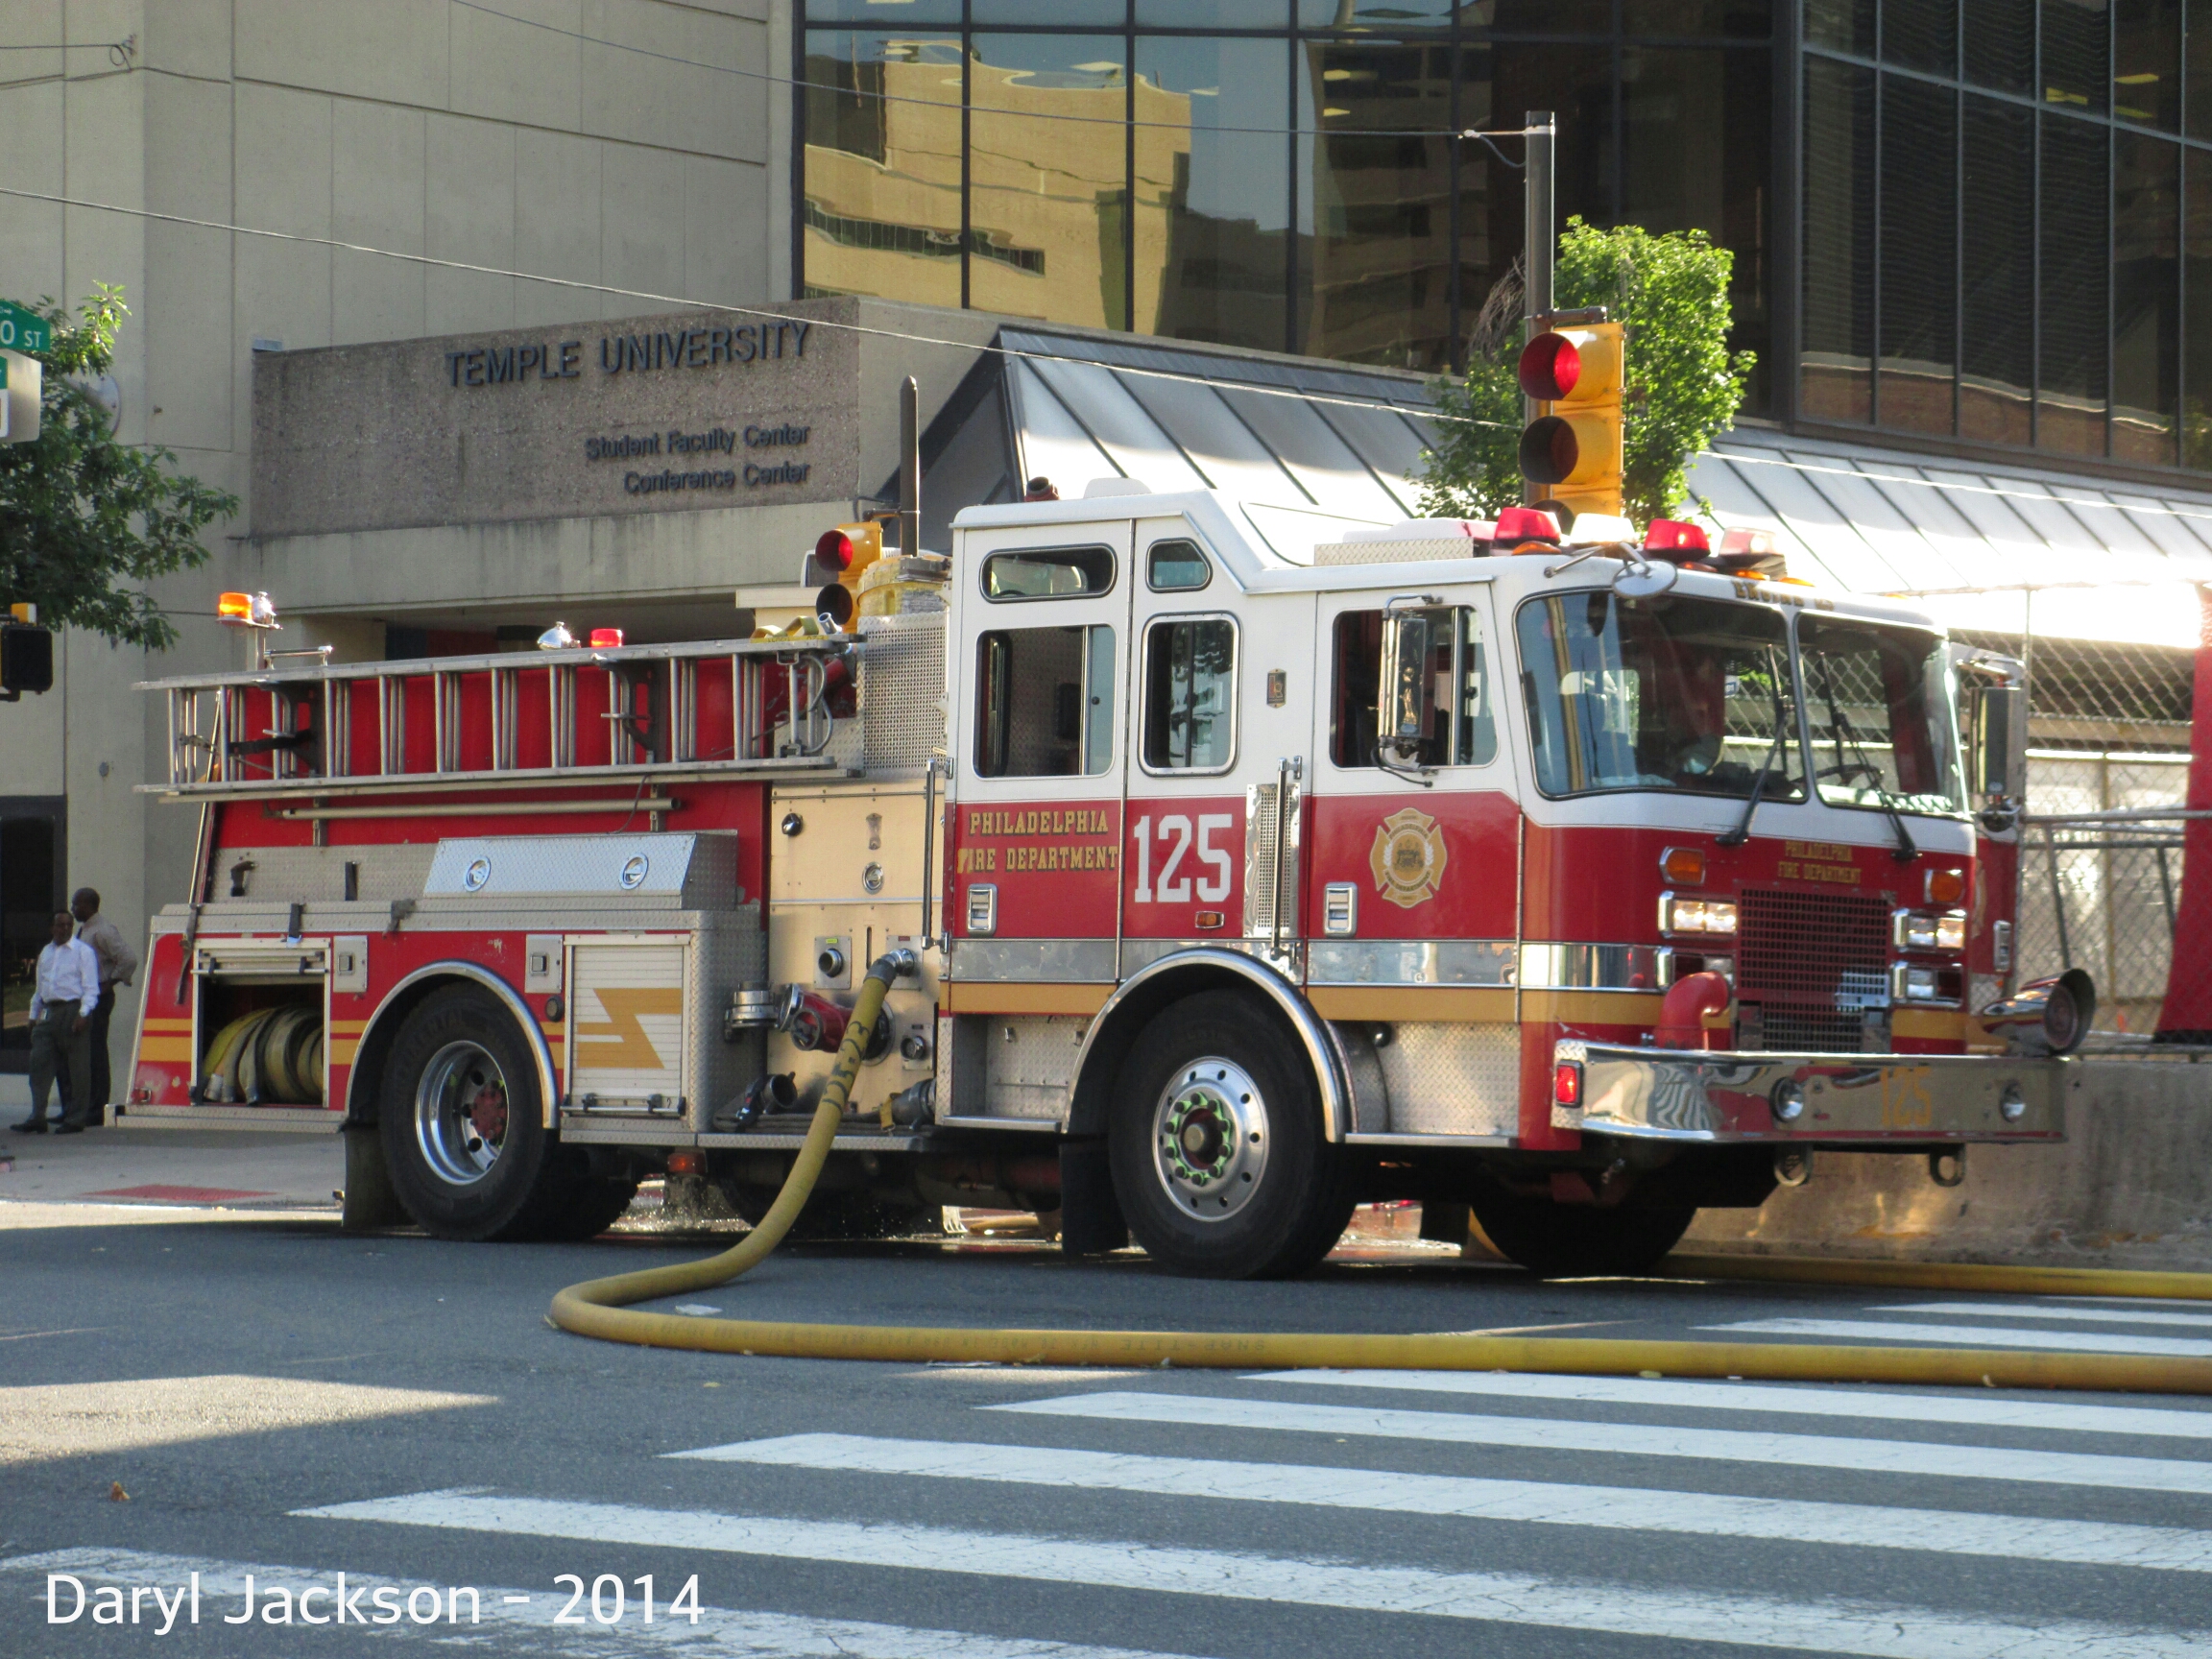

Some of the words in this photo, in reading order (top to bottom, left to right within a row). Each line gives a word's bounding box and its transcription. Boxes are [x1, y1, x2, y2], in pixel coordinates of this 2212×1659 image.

[24, 330, 42, 348] ST
[445, 342, 581, 388] TEMPLE
[599, 322, 810, 374] UNIVERSITY
[585, 432, 661, 461] Student
[666, 428, 736, 454] Faculty
[742, 422, 810, 447] Center
[624, 469, 736, 494] Conference
[742, 461, 810, 487] Center
[970, 810, 1109, 836] PHILADELPHIA
[956, 848, 996, 874] FIRE
[1005, 846, 1118, 872] DEPARTMENT
[1134, 814, 1233, 902] 125
[1777, 861, 1800, 879] FIRE
[1803, 863, 1862, 883] DEPARTMENT
[1881, 1066, 1932, 1128] 125
